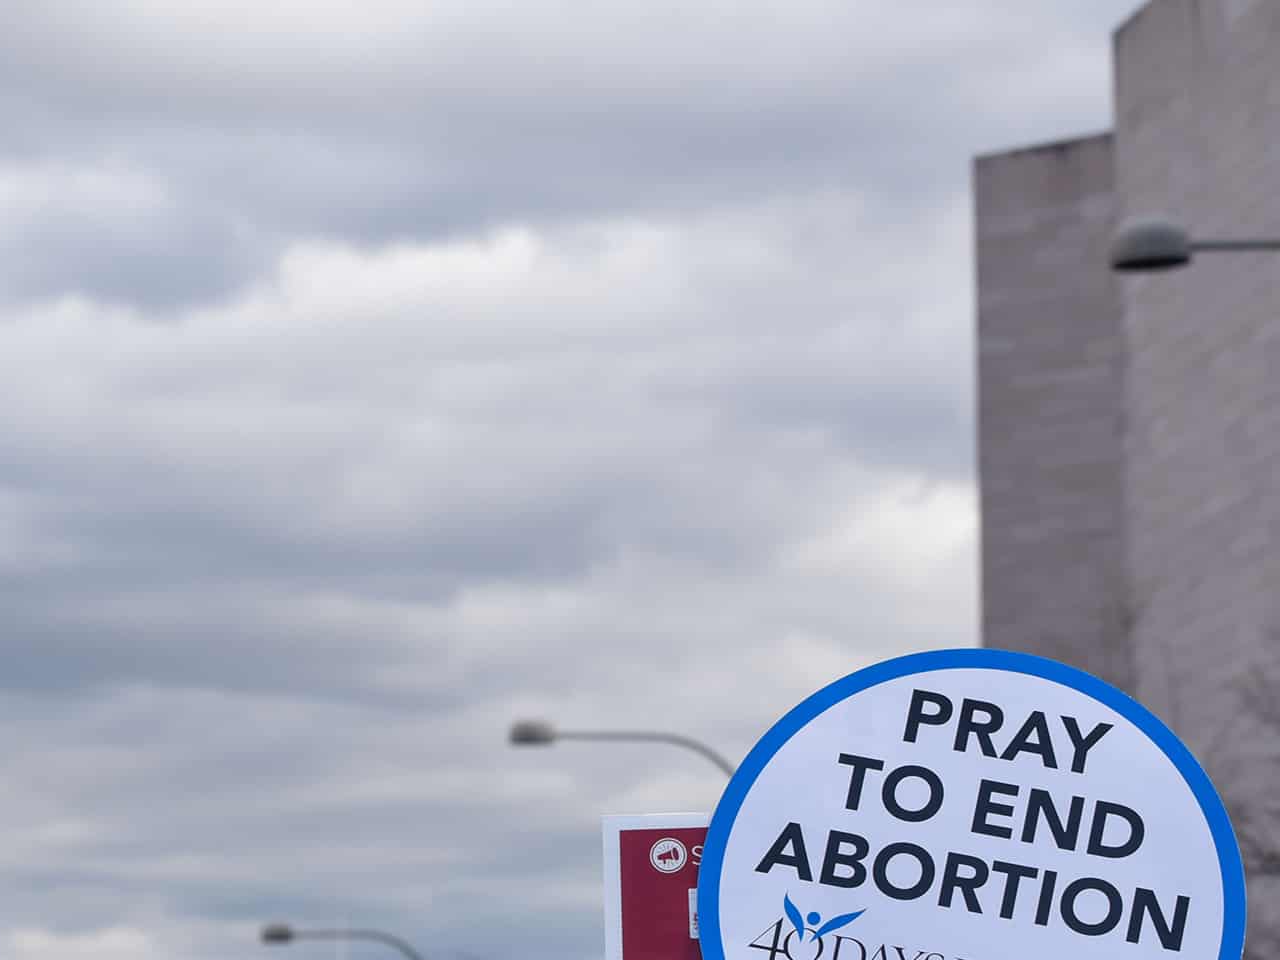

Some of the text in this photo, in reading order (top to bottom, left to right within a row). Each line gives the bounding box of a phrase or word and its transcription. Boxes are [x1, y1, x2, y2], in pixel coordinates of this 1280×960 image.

[903, 689, 1114, 774] PRAY
[837, 752, 1145, 859] TO END
[754, 822, 1191, 952] ABORTION
